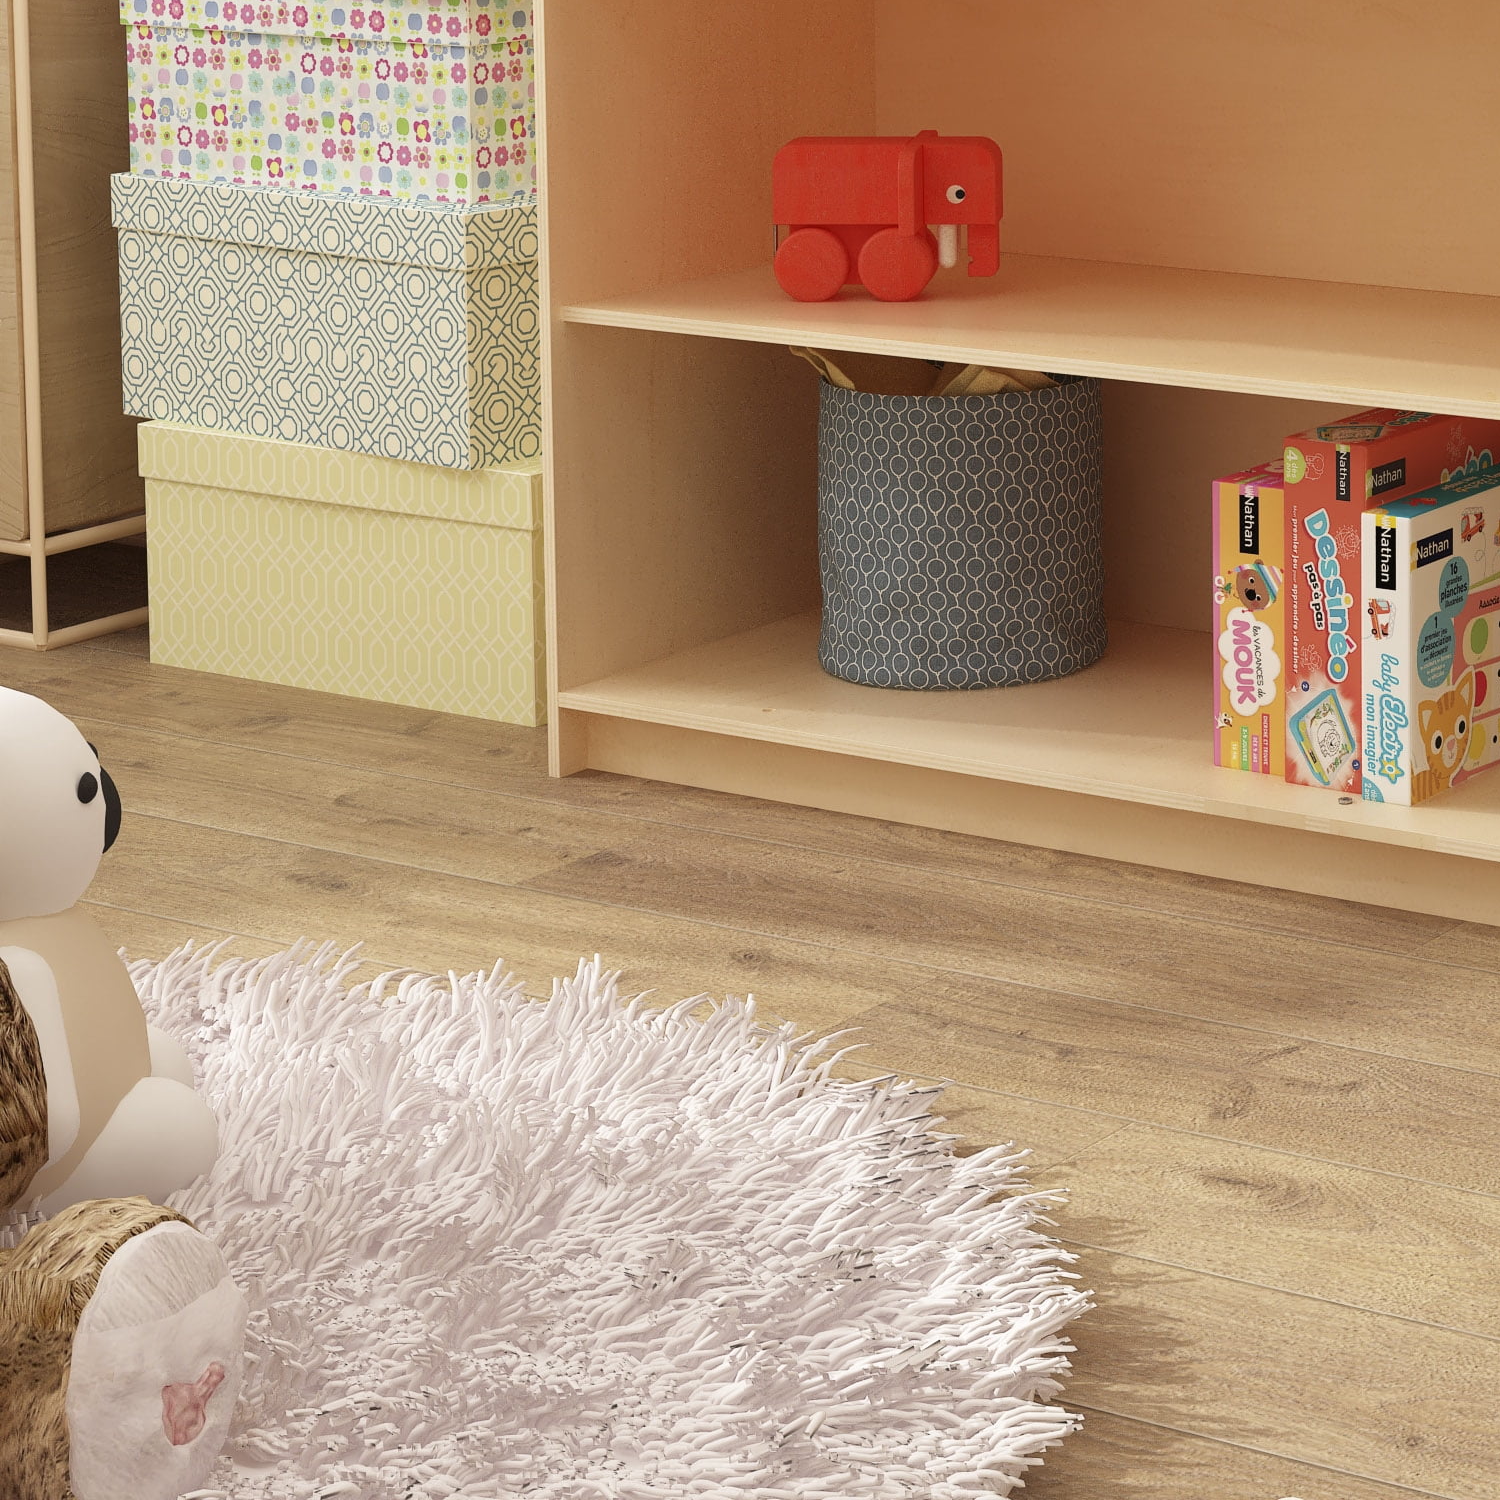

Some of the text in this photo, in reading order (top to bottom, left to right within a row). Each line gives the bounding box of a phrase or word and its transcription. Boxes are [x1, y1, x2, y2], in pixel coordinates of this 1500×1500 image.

[1286, 450, 1299, 461] 4
[1340, 451, 1348, 495] Nathan
[1372, 468, 1402, 488] Nathan
[1244, 494, 1255, 548] Nathan
[1291, 553, 1300, 570] jeu
[1381, 527, 1391, 582] Nathan
[1417, 538, 1449, 560] Nathan
[1451, 562, 1458, 576] 16
[1291, 584, 1299, 631] apprendre
[1305, 509, 1356, 681] Dessinéo
[1305, 564, 1324, 628] pas à pas
[1441, 583, 1468, 602] planches
[1479, 595, 1500, 610] Associe
[1434, 616, 1438, 629] 1
[1232, 619, 1257, 705] MOUK
[1252, 625, 1266, 698] les VACANCES de
[1292, 635, 1300, 674] dessiner
[1364, 693, 1376, 776] mon imagier
[1373, 653, 1408, 785] baby Electro
